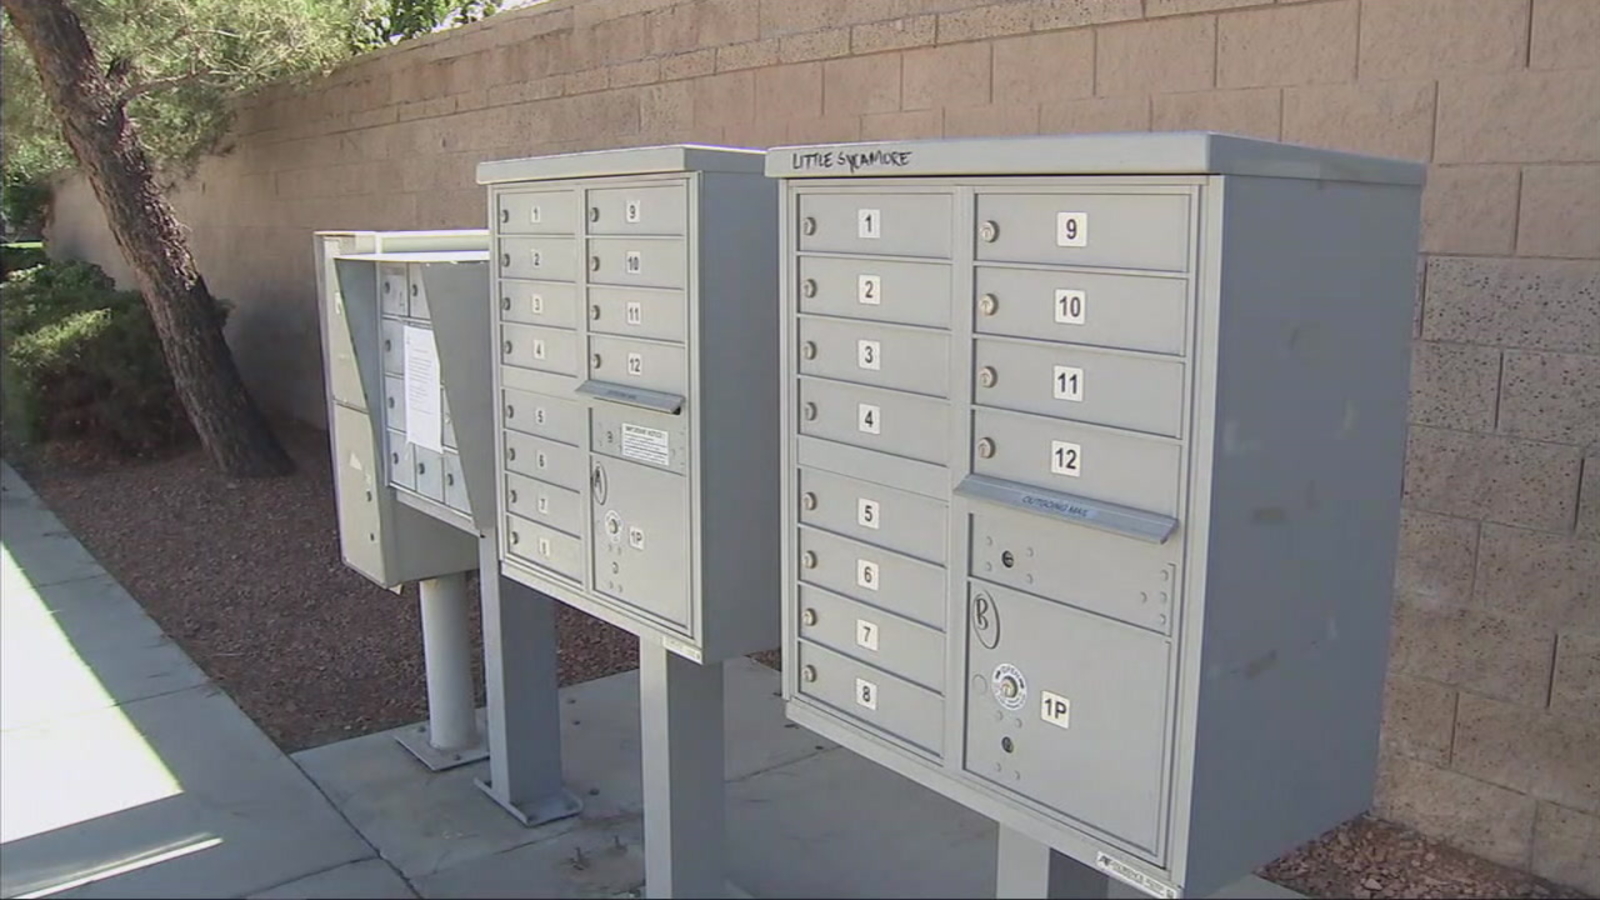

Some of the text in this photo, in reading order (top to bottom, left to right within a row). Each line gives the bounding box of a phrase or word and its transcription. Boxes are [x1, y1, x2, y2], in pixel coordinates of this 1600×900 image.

[793, 149, 912, 173] LITTLE SYCAMORE
[865, 214, 872, 232] 1
[1066, 218, 1077, 240] 9
[865, 280, 874, 299] 2
[1059, 295, 1081, 318] 10
[864, 345, 874, 364] 3
[1057, 372, 1077, 395] 11
[864, 410, 874, 428] 4
[1055, 447, 1077, 470] 12
[864, 504, 873, 523] 5
[864, 565, 872, 584] 6
[975, 595, 989, 630] B
[863, 625, 871, 642] 7
[862, 685, 871, 703] 8
[1044, 698, 1067, 719] 1P
